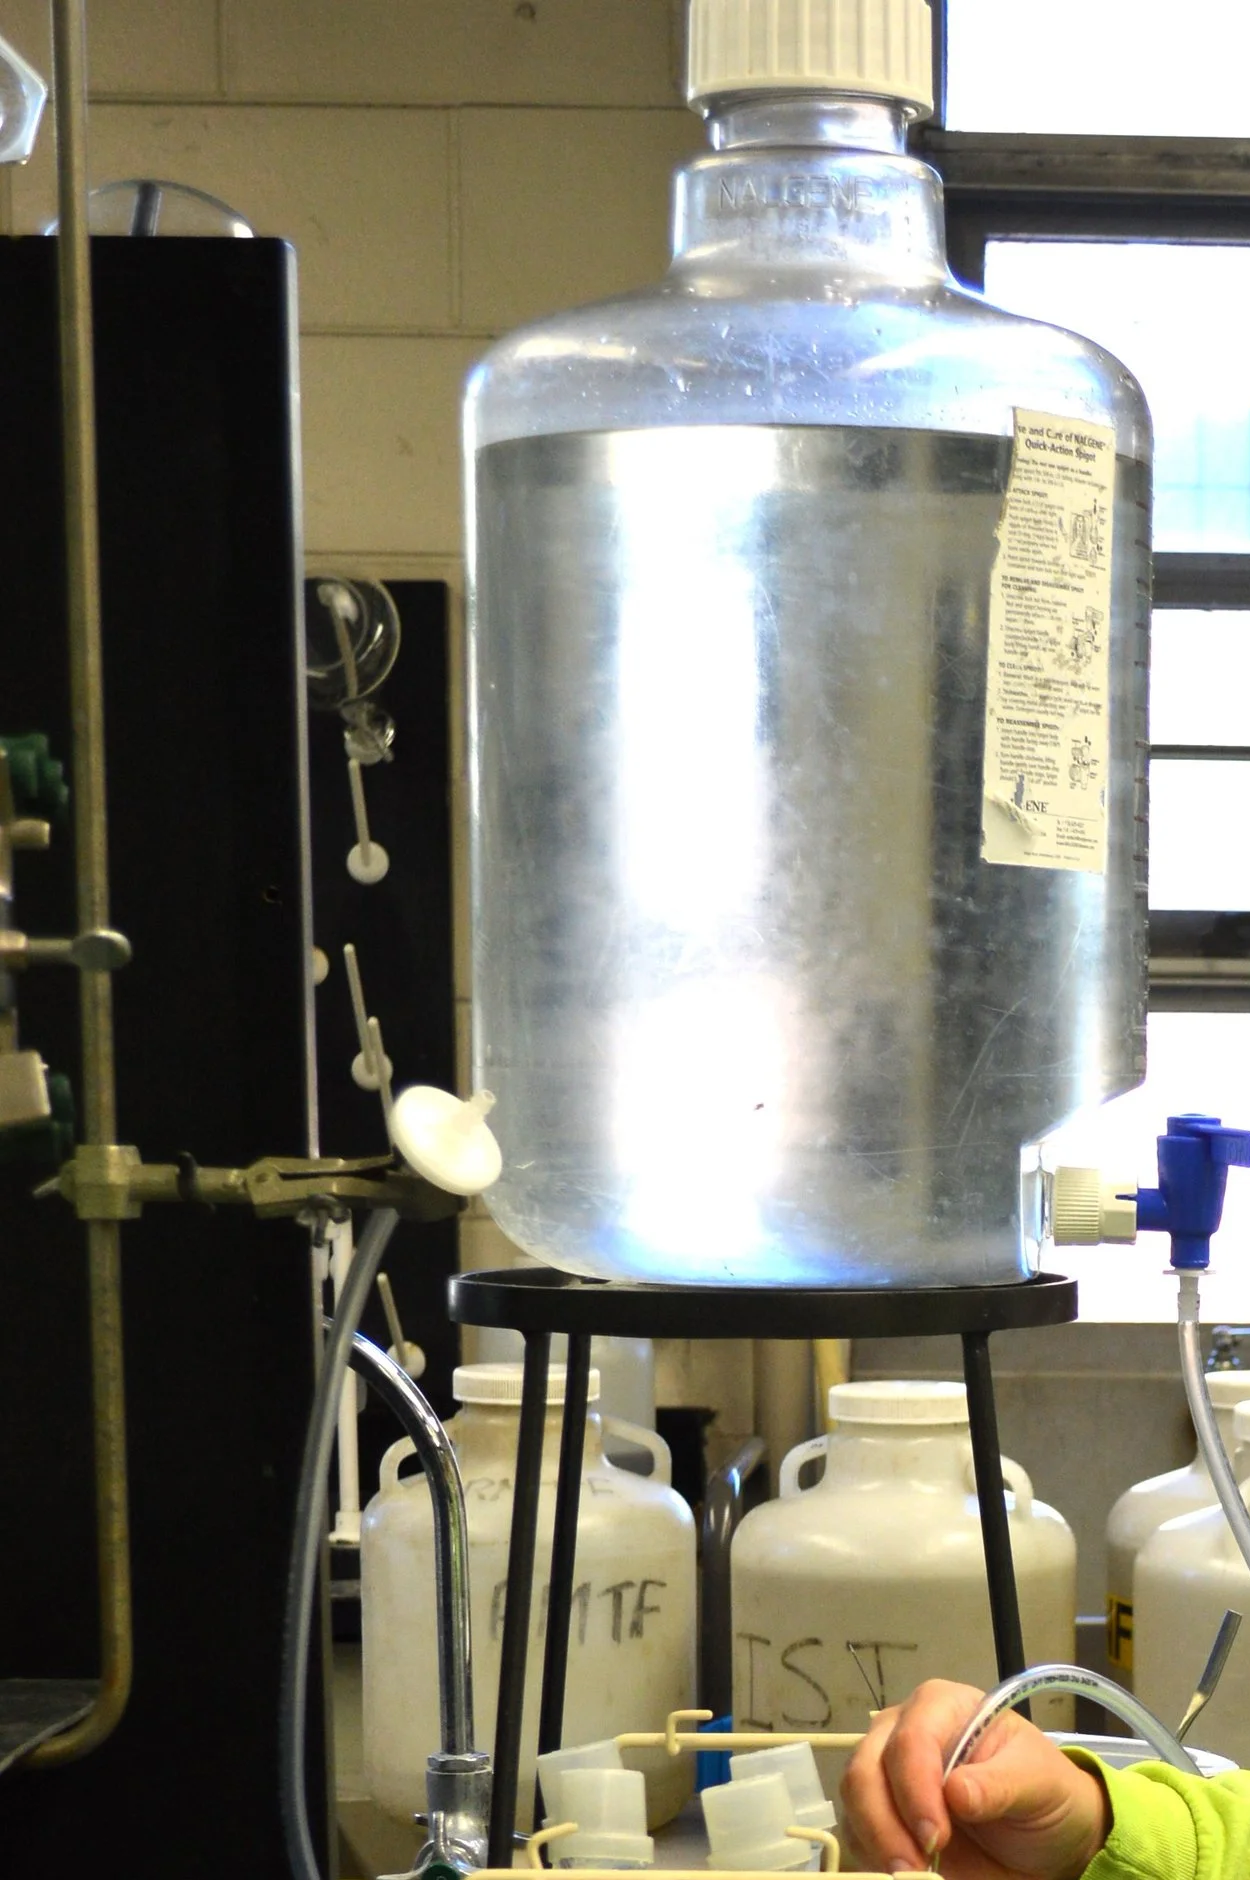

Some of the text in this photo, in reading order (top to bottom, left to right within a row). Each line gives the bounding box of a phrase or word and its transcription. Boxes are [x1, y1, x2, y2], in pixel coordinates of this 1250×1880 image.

[719, 174, 876, 211] NALGENE
[1029, 427, 1044, 437] and
[1046, 428, 1064, 440] Cre
[1065, 432, 1074, 442] of
[1025, 438, 1096, 463] Quick-Action Spigot
